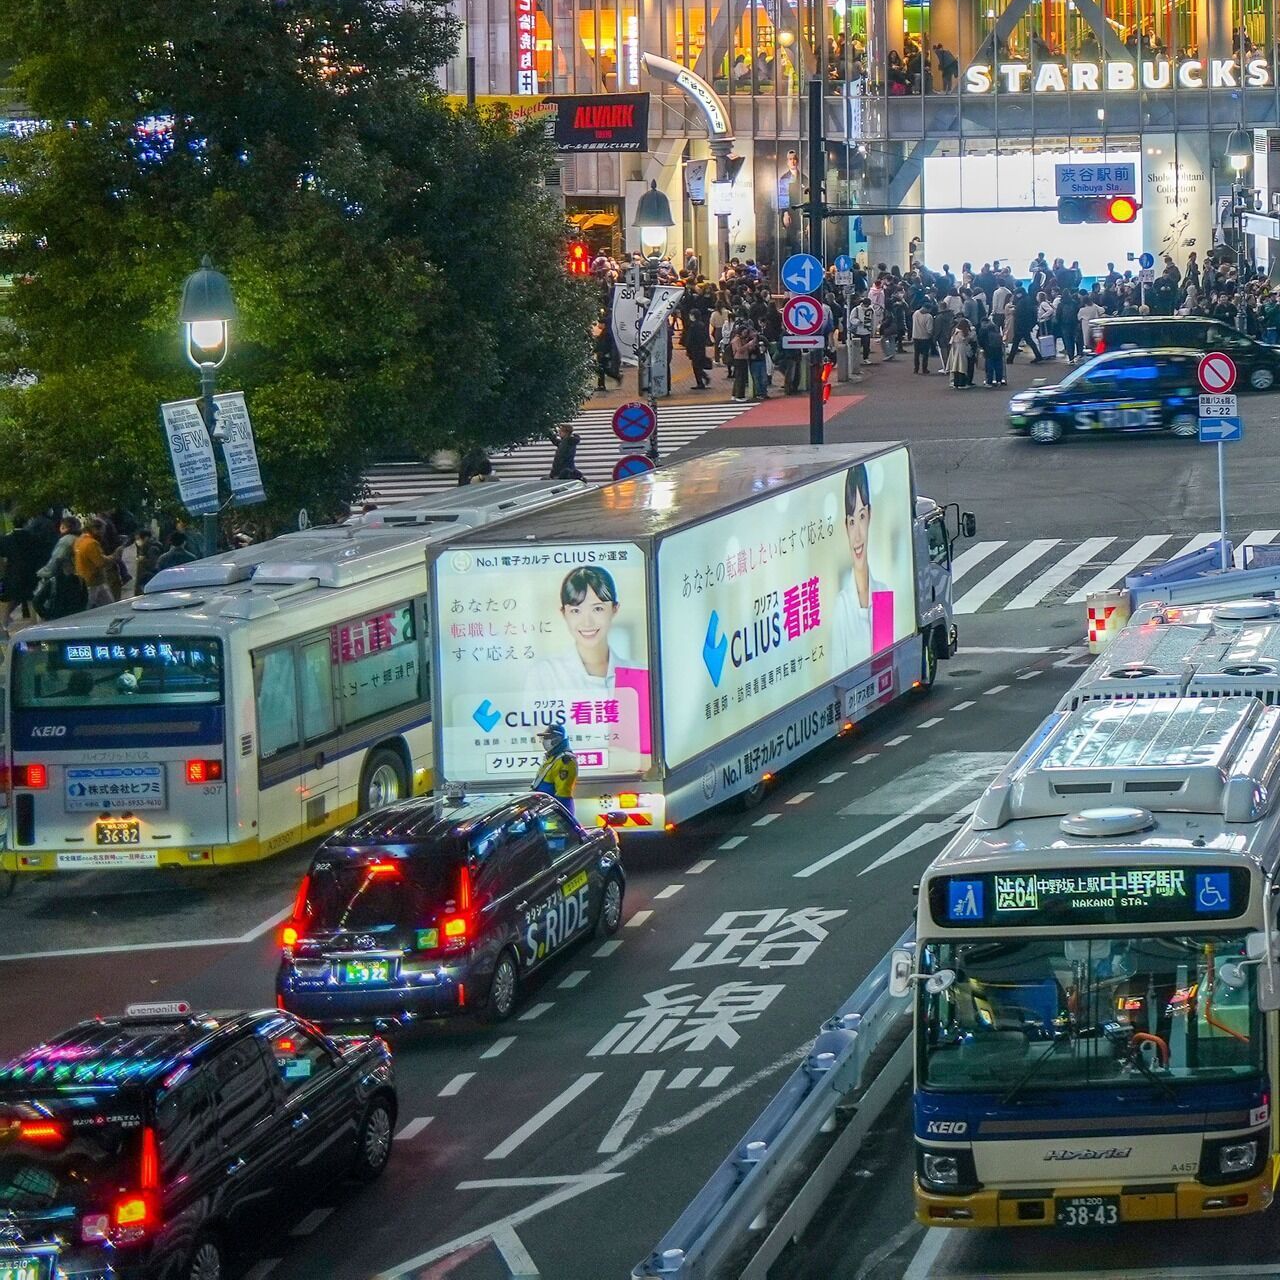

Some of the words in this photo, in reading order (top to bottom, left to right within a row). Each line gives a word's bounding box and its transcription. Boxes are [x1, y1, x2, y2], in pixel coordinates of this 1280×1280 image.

[966, 59, 1270, 93] STARBUCKS
[1061, 167, 1129, 182] 渋谷駅前
[1071, 184, 1103, 193] Shibuya
[1106, 183, 1122, 192] Sta.
[1205, 407, 1231, 416] 6-22
[476, 556, 499, 568] No.1
[501, 555, 551, 567] 電子カルテ
[553, 551, 597, 565] CLIUS
[598, 550, 629, 562] が運営
[682, 516, 835, 599] あなたの転職したいにすぐ応える
[450, 597, 518, 614] あなたの
[753, 591, 780, 616] クリアス
[783, 575, 822, 642] 看護
[448, 620, 553, 639] 転職したいに
[730, 611, 781, 669] CLIUS
[451, 644, 536, 662] すぐ応える
[533, 699, 565, 709] クリアス
[570, 699, 620, 725] 看護
[504, 708, 567, 728] CLIUS
[31, 725, 67, 738] KEIO
[744, 733, 785, 775] 電子カルテ
[785, 710, 820, 751] CLIUS
[1037, 877, 1100, 894] 中野坂上駅
[1100, 869, 1187, 899] 中野駅
[1072, 898, 1115, 908] NAKANO
[1121, 897, 1149, 907] STA.
[927, 1121, 967, 1135] KEIO
[1043, 1146, 1133, 1162] Hybrid
[1170, 1162, 1198, 1173] A457
[1063, 1205, 1118, 1226] 38-43
